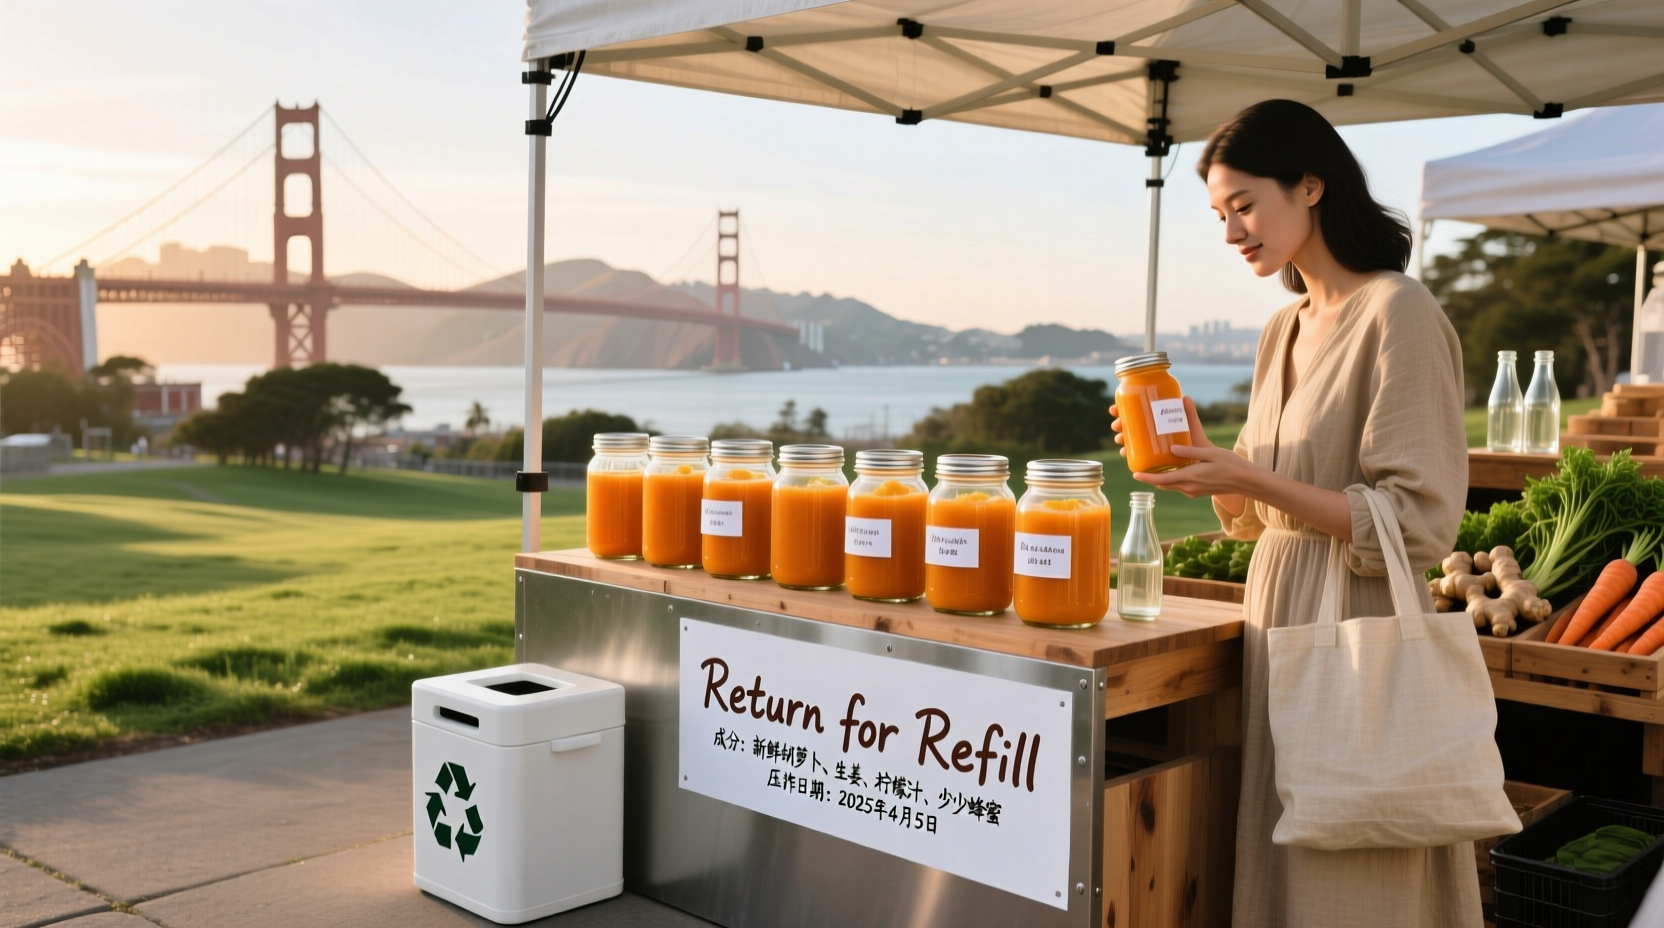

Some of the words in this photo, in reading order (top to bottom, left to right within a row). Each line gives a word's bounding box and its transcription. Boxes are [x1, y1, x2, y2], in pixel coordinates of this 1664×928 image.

[700, 657, 825, 734] Return
[839, 692, 900, 754] for
[914, 707, 1041, 793] Refill
